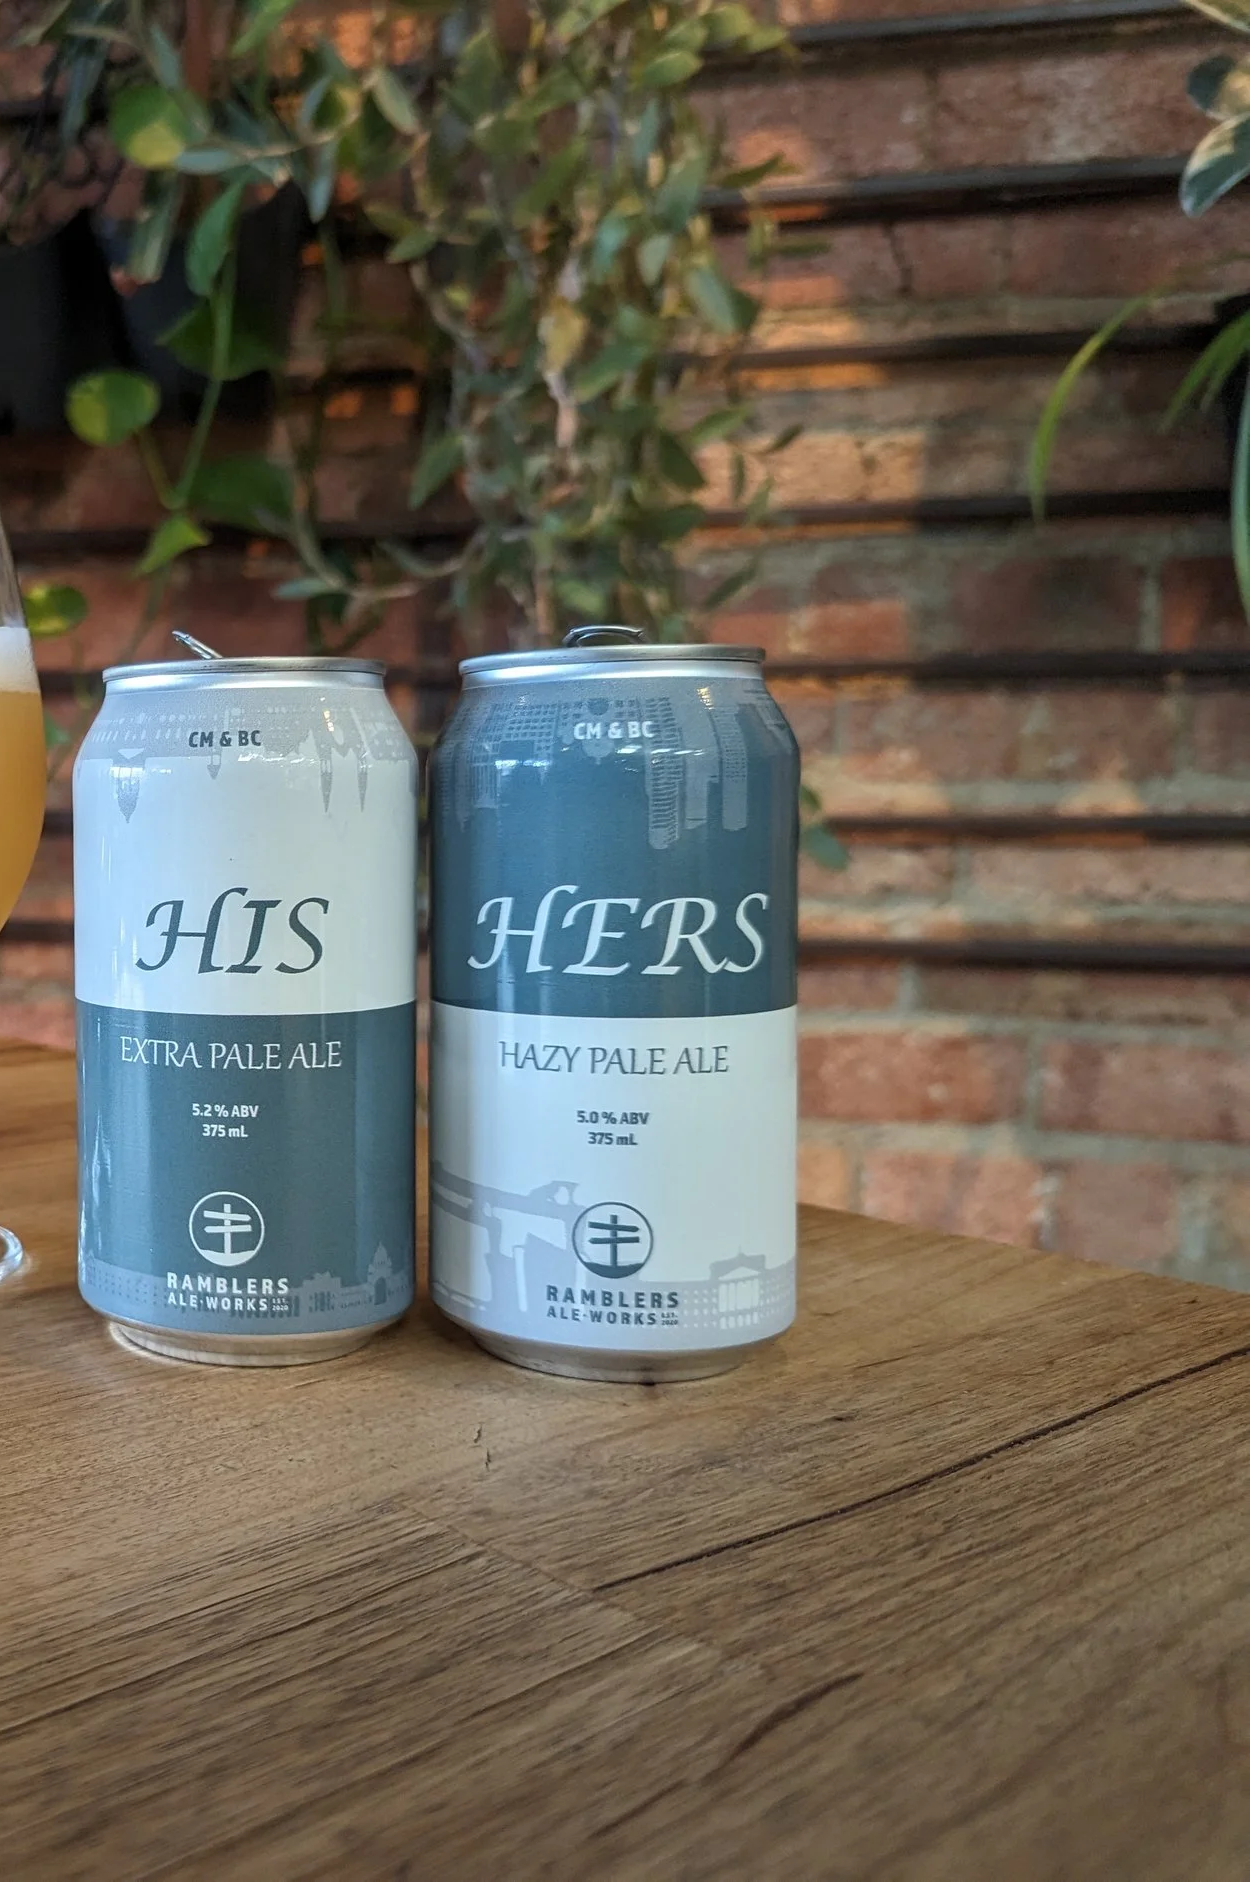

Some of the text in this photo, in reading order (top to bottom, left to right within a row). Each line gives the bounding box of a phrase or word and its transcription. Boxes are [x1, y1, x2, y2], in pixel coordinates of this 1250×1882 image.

[188, 730, 262, 748] CM & BC
[573, 721, 656, 740] CM & BC
[135, 887, 330, 975] HIS
[466, 884, 770, 976] HERS
[120, 1036, 343, 1070] EXTRA PALE ALE
[498, 1041, 730, 1075] HAZY PALE ALE
[231, 1105, 259, 1118] ABV
[620, 1112, 650, 1125] ABV
[202, 1124, 249, 1138] 375 mL
[587, 1131, 638, 1146] 375 mL
[167, 1272, 289, 1295] RAMBLERS
[546, 1285, 679, 1309] RAMBLERS
